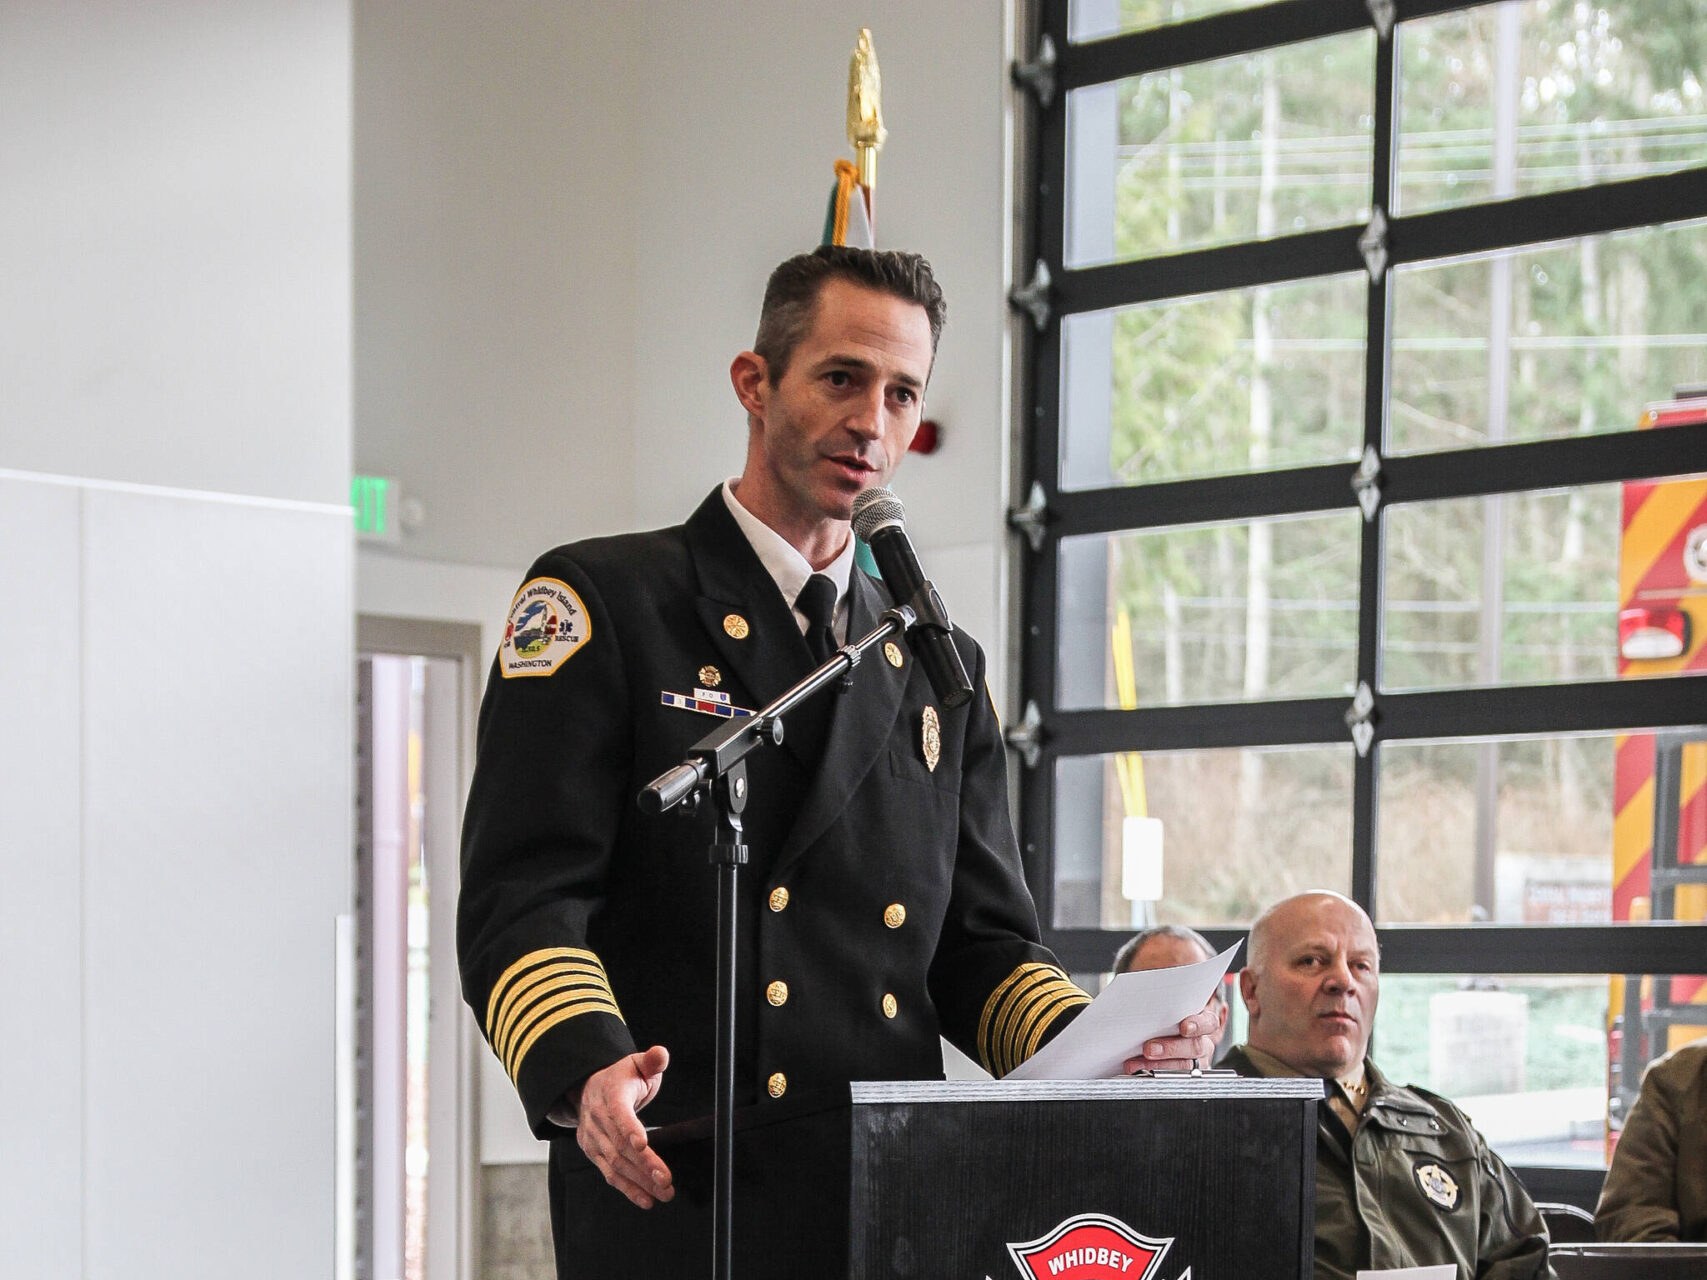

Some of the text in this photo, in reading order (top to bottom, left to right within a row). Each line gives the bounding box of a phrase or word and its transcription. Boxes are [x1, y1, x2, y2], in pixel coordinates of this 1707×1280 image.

[556, 592, 577, 616] Island
[508, 660, 552, 669] WASHINGTON
[1047, 1247, 1134, 1276] WHIDBEY
